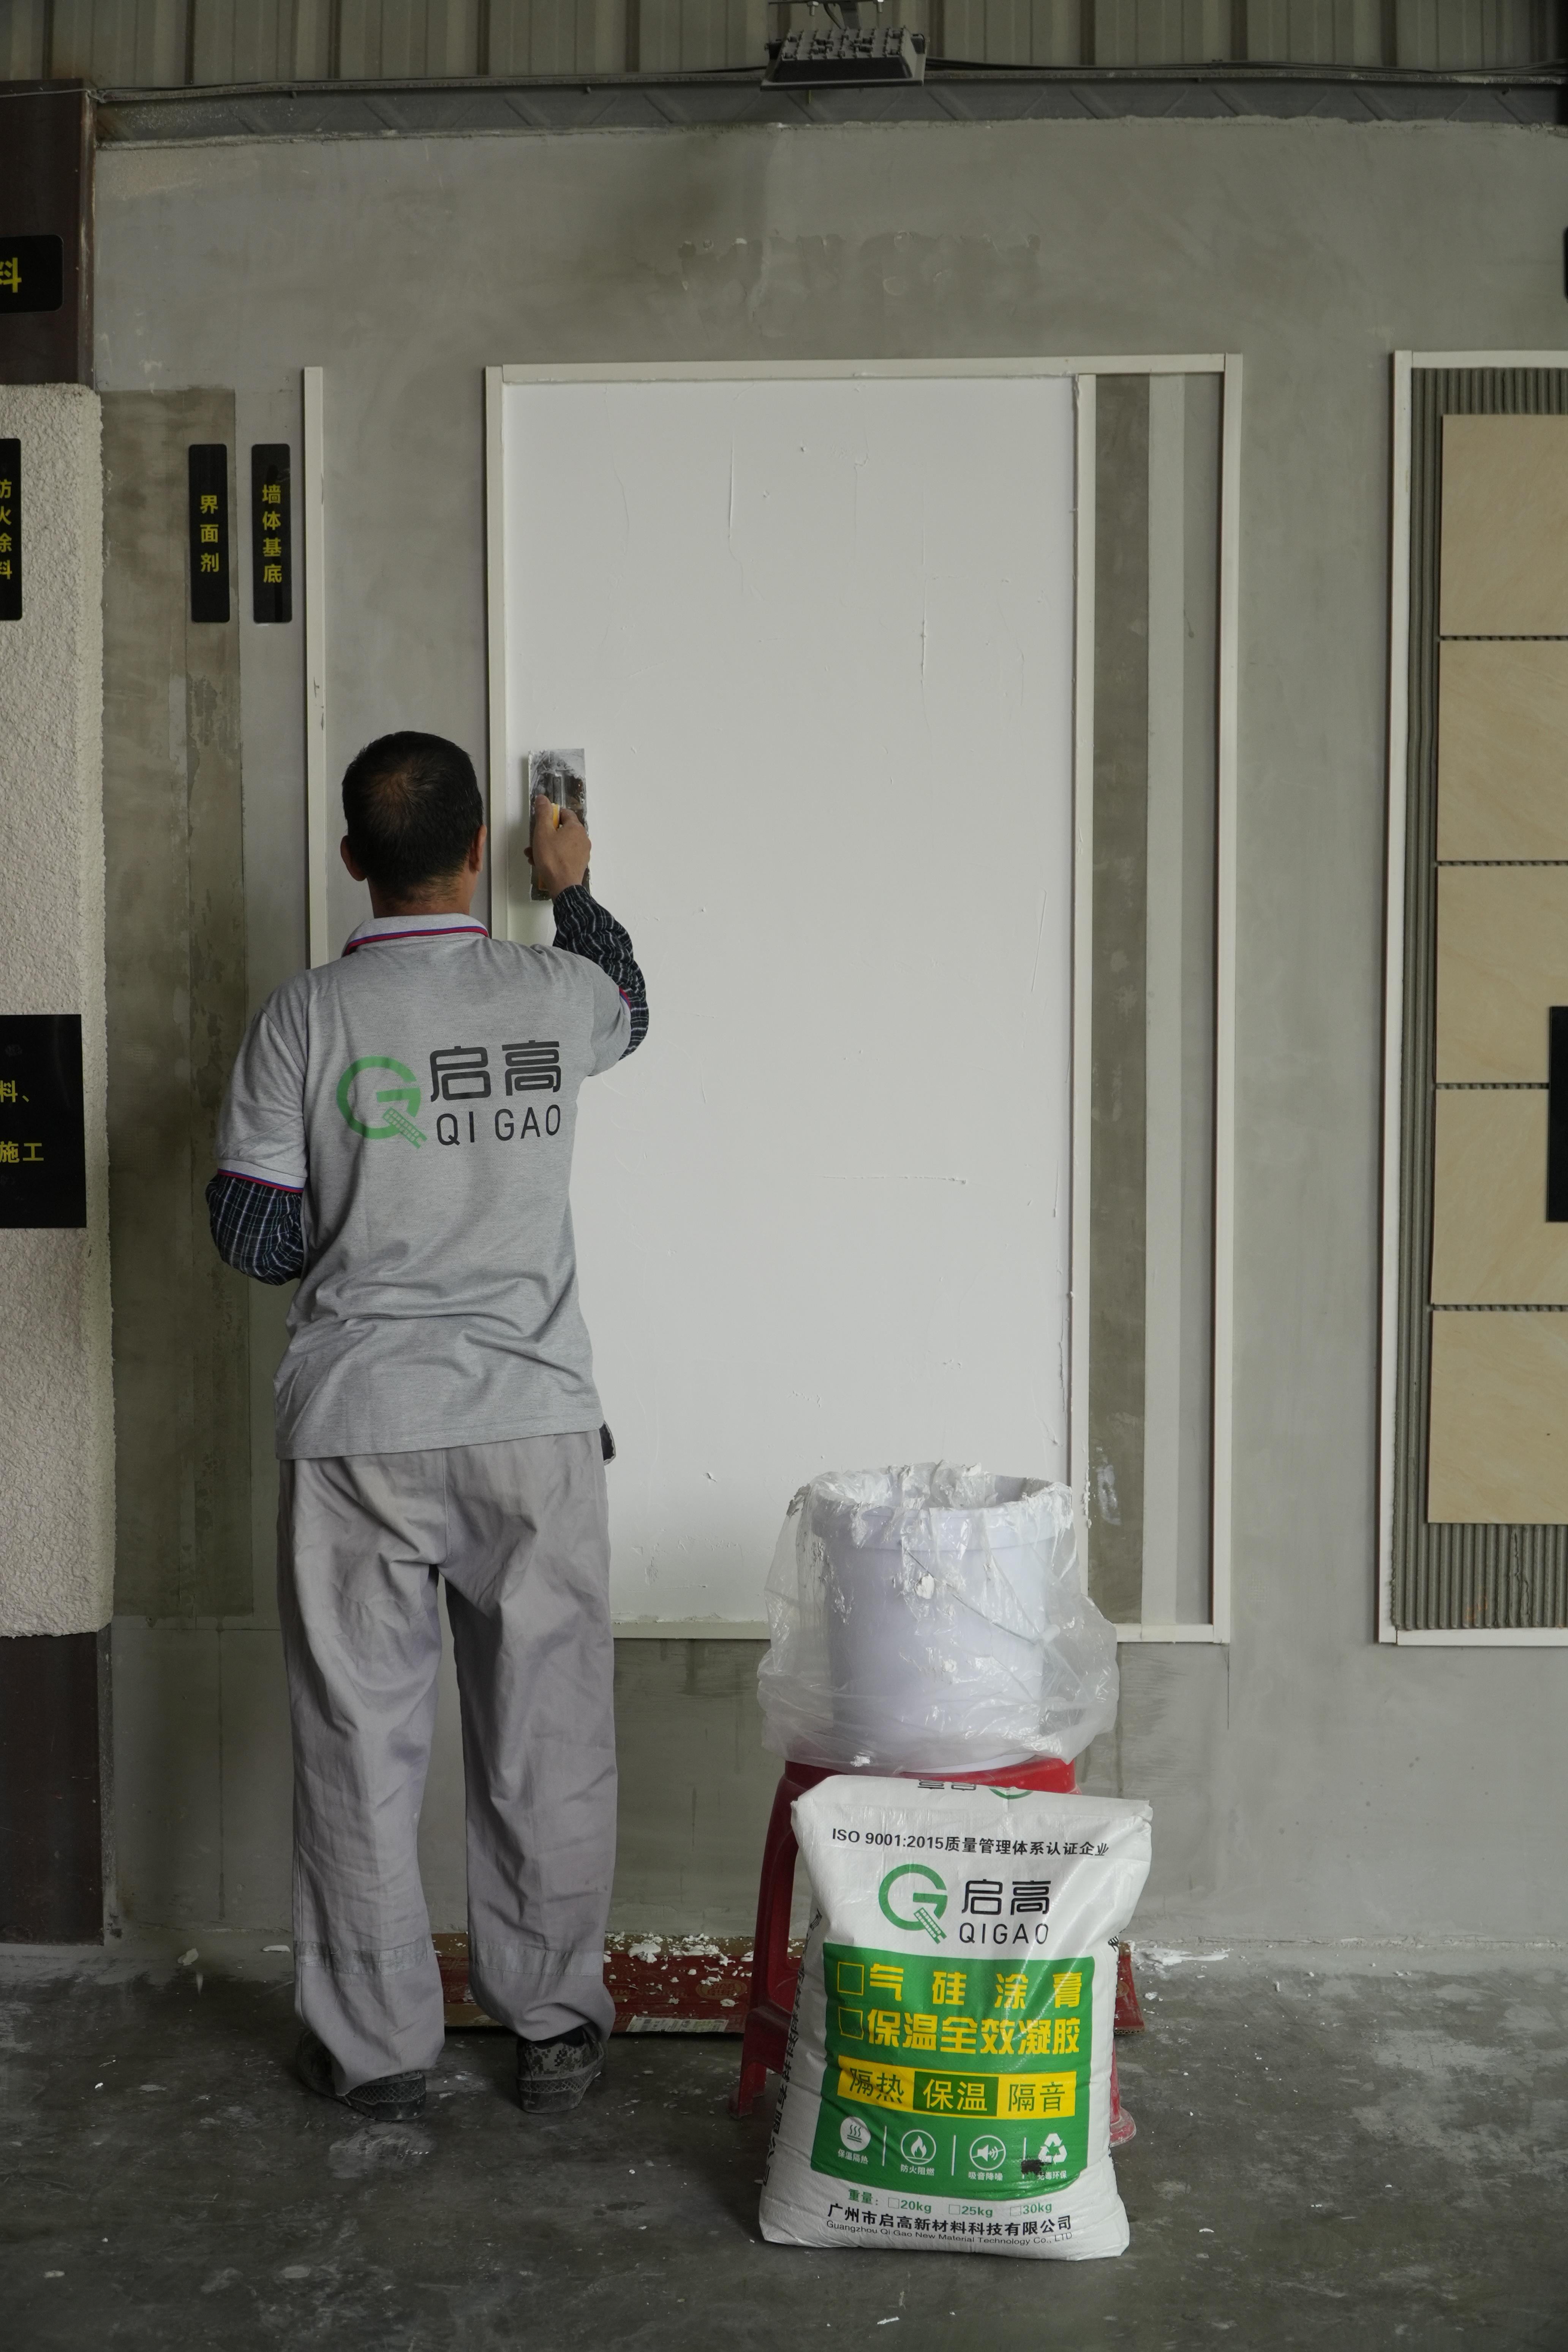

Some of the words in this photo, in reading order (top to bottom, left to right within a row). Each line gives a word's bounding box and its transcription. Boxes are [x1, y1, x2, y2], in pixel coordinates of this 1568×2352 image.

[200, 495, 219, 573] 界面剂
[262, 484, 283, 583] 墙体基底
[430, 1040, 561, 1102] 启高
[437, 1111, 475, 1146] QI
[495, 1105, 561, 1141] GAO
[0, 1141, 44, 1163] 施工
[832, 1828, 860, 1843] ISO
[962, 1878, 1052, 1917] 启高
[867, 2011, 1080, 2055] 保温全效凝胶
[849, 2067, 905, 2104] 隔热
[923, 2078, 988, 2112] 保温
[1008, 2080, 1065, 2113] 隔音
[838, 2149, 869, 2164] 保温隔热
[901, 2164, 935, 2176] 防火阻燃
[968, 2172, 1003, 2181] 吸音降噪
[828, 2203, 1071, 2237] 广州市启高新材料科技有限公司
[901, 2200, 932, 2213] 20kg
[961, 2206, 993, 2218] 25kg
[1023, 2203, 1052, 2215] 30kg
[827, 2221, 877, 2234] Guangzhou
[939, 2234, 975, 2242] Material
[978, 2237, 1030, 2246] Technology
[1054, 2232, 1072, 2242] LTD
